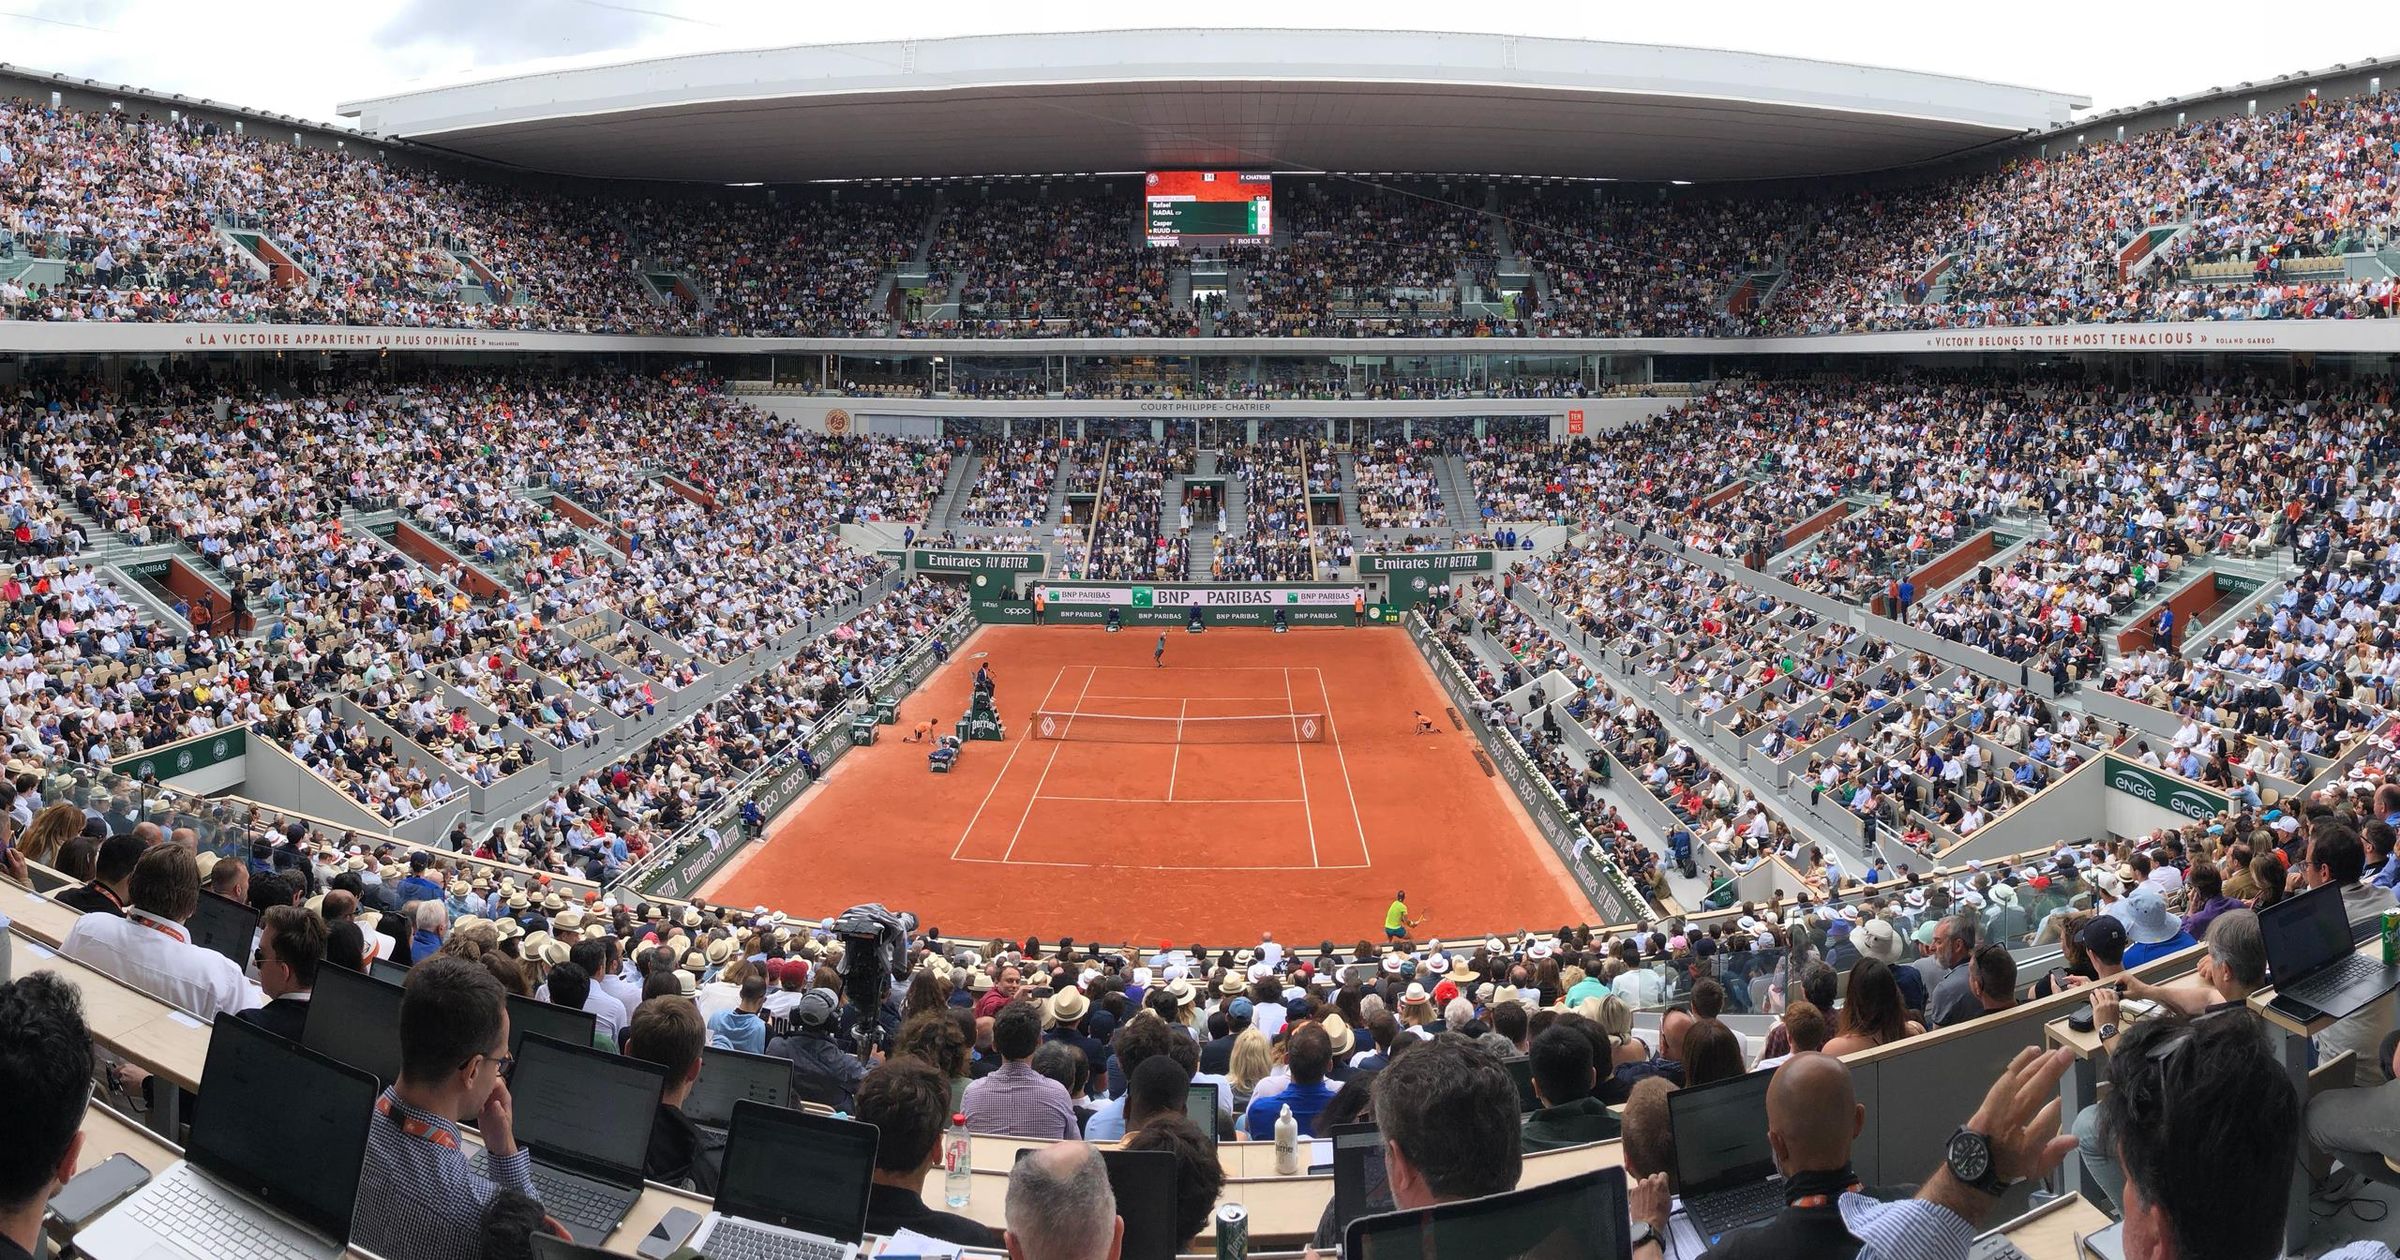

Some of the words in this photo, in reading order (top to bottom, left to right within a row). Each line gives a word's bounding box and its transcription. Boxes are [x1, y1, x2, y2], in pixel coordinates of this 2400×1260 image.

[200, 333, 216, 345] LA
[223, 333, 289, 345] VICTOIRE
[295, 334, 372, 345] APPARTIENT
[376, 335, 390, 345] AU
[396, 336, 421, 345] PLUS
[425, 334, 478, 346] OPINIÂTRE
[1935, 336, 1974, 347] VICTORY
[1979, 336, 2025, 347] BELONGS
[2030, 335, 2043, 346] TO
[2048, 335, 2069, 346] THE
[2073, 334, 2106, 346] MOST
[2111, 333, 2193, 345] TENACIOUS
[1140, 403, 1173, 411] COURT
[1175, 403, 1217, 411] PHILIPPE
[1225, 403, 1271, 411] CHATRIER
[1570, 413, 1582, 421] TEN
[1570, 424, 1582, 432] NIS
[135, 562, 167, 574] PARIBAS
[928, 554, 982, 568] Emirates
[985, 556, 999, 568] FLY
[1000, 557, 1029, 568] BETTER
[1374, 557, 1430, 570] Emirates
[1434, 556, 1448, 568] FLY
[1449, 555, 1478, 568] BETTER
[2218, 577, 2233, 587] BNP
[1158, 591, 1190, 604] BNP
[1207, 590, 1272, 604] PARIBAS
[1300, 592, 1317, 600] BNP
[1318, 592, 1350, 600] PARIBAS
[1003, 607, 1031, 616] oppo
[1489, 736, 1505, 760] oppo
[1503, 756, 1520, 781] oppo
[781, 767, 805, 795] oppo
[1519, 777, 1537, 806] oppo
[1537, 804, 1559, 838] Emirates
[681, 848, 716, 884] Emirates
[722, 824, 741, 849] BETTER
[1574, 856, 1599, 896] Emirates
[1596, 884, 1609, 905] FLY
[1601, 893, 1622, 921] BETTER
